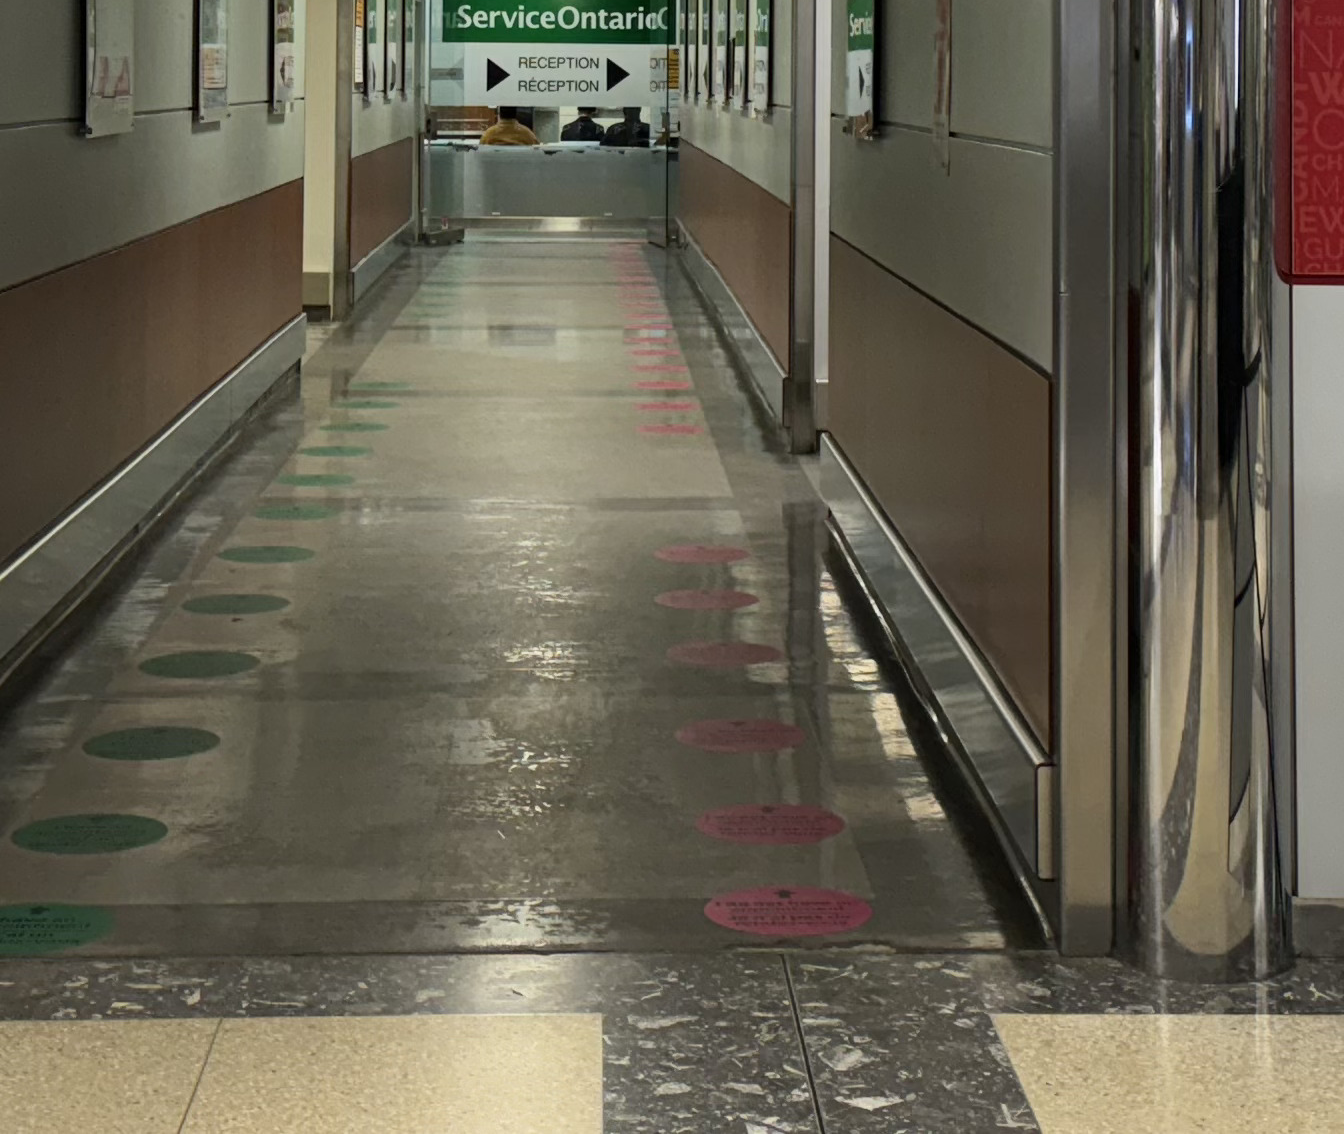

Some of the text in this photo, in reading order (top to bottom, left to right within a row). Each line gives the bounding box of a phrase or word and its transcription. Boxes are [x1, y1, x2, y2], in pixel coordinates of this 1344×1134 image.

[457, 5, 658, 30] ServiceOntario
[518, 57, 599, 69] RECEPTION
[518, 77, 599, 92] RÉCEPTION
